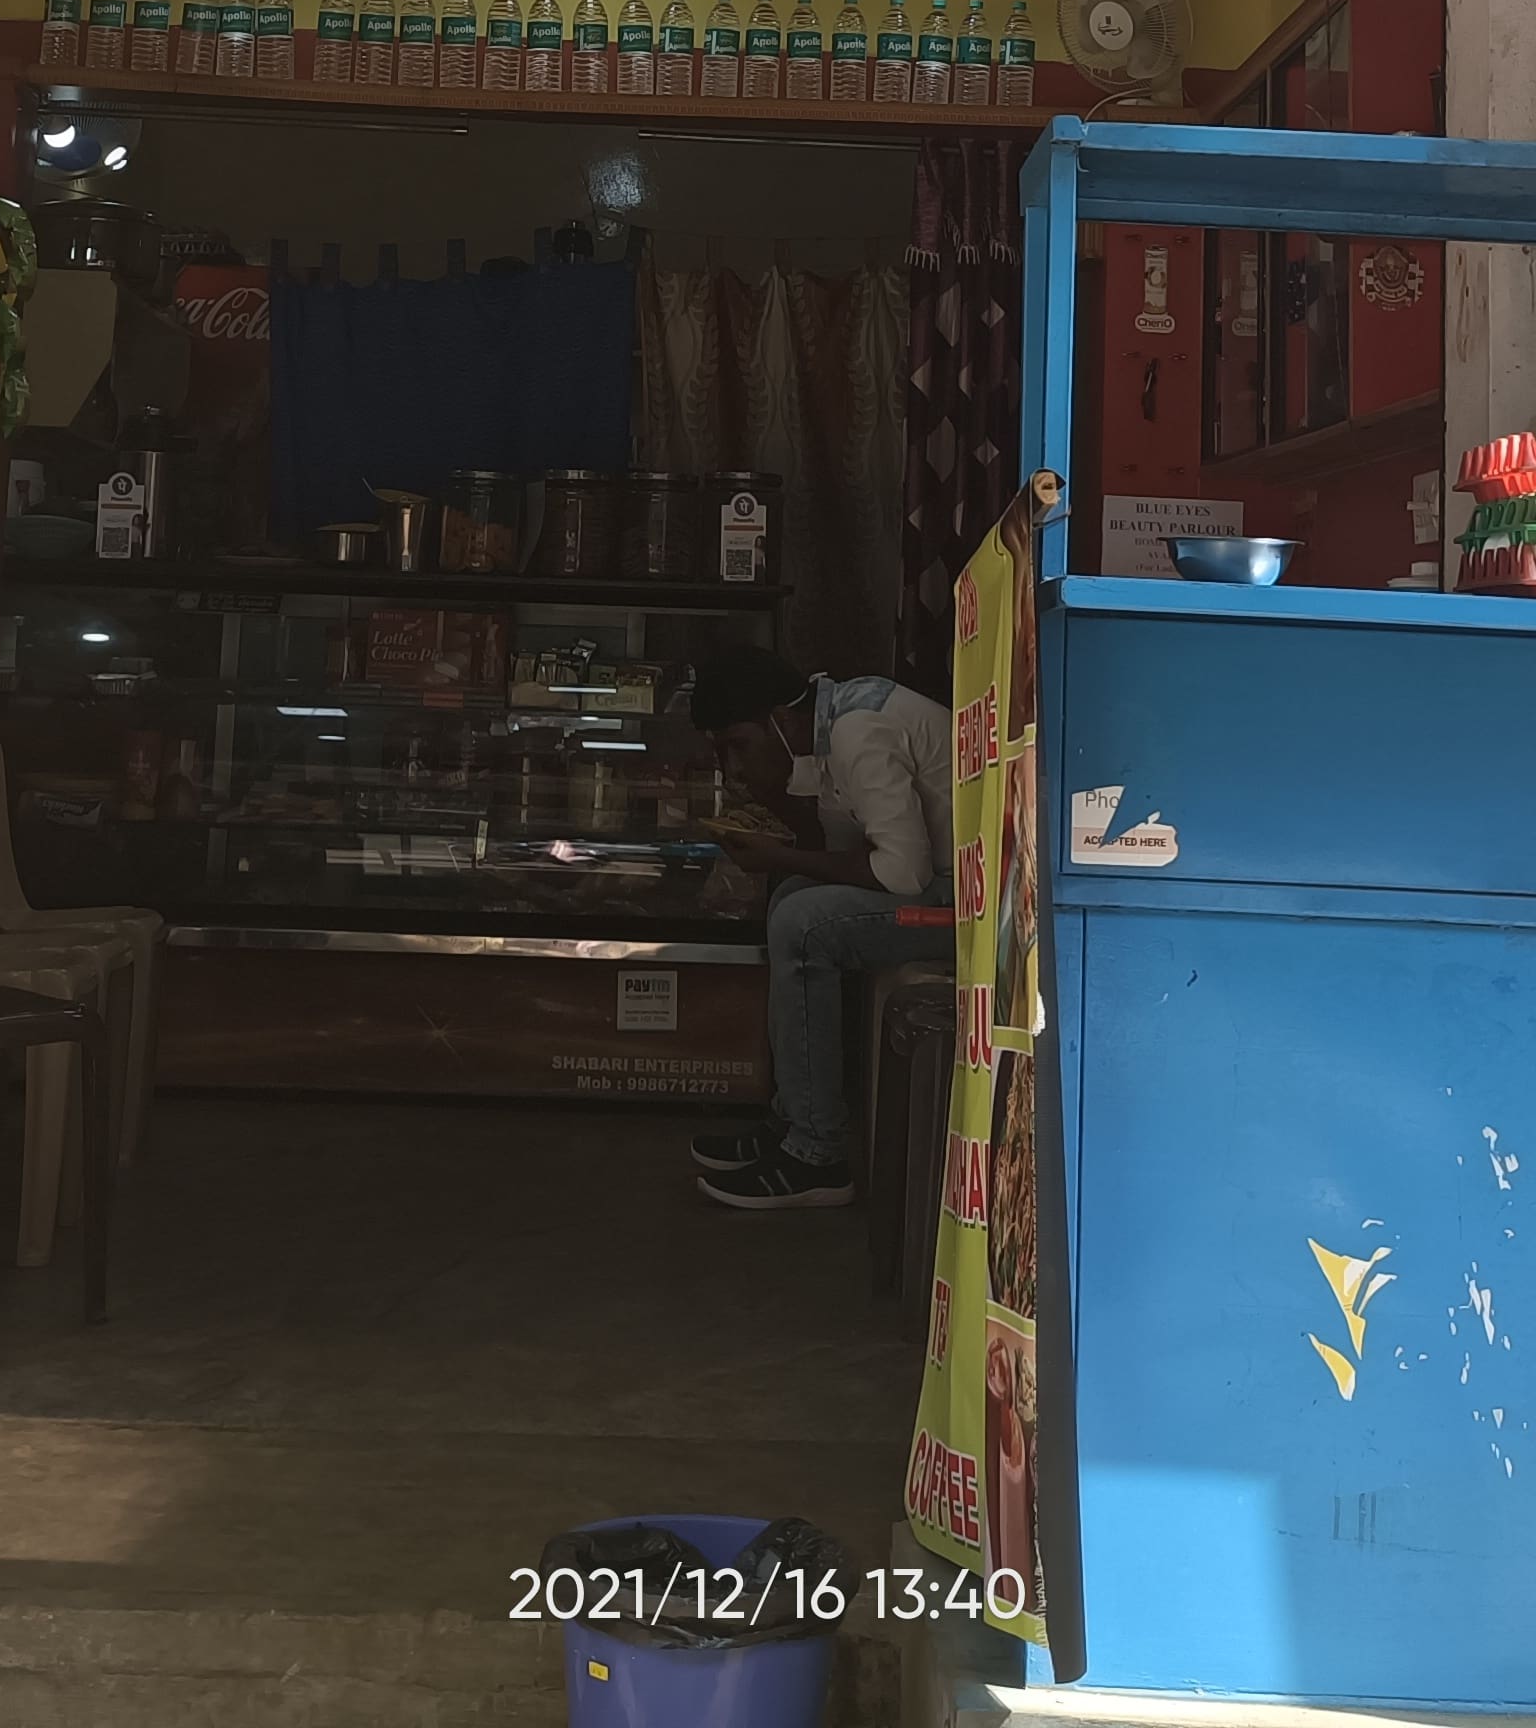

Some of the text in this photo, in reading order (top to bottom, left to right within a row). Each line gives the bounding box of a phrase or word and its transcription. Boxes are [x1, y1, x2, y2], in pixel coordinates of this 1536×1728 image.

[1135, 502, 1211, 517] BLUE EYES
[1109, 519, 1236, 536] BEAUTY PARLOUR
[372, 630, 414, 647] Lotte
[370, 646, 418, 663] Choco
[1139, 837, 1167, 848] HERE
[551, 1055, 754, 1076] SHABARI ENTERPRISES
[576, 1075, 612, 1090] Mob
[627, 1077, 729, 1094] 9986712773
[905, 1427, 981, 1549] COFFEE
